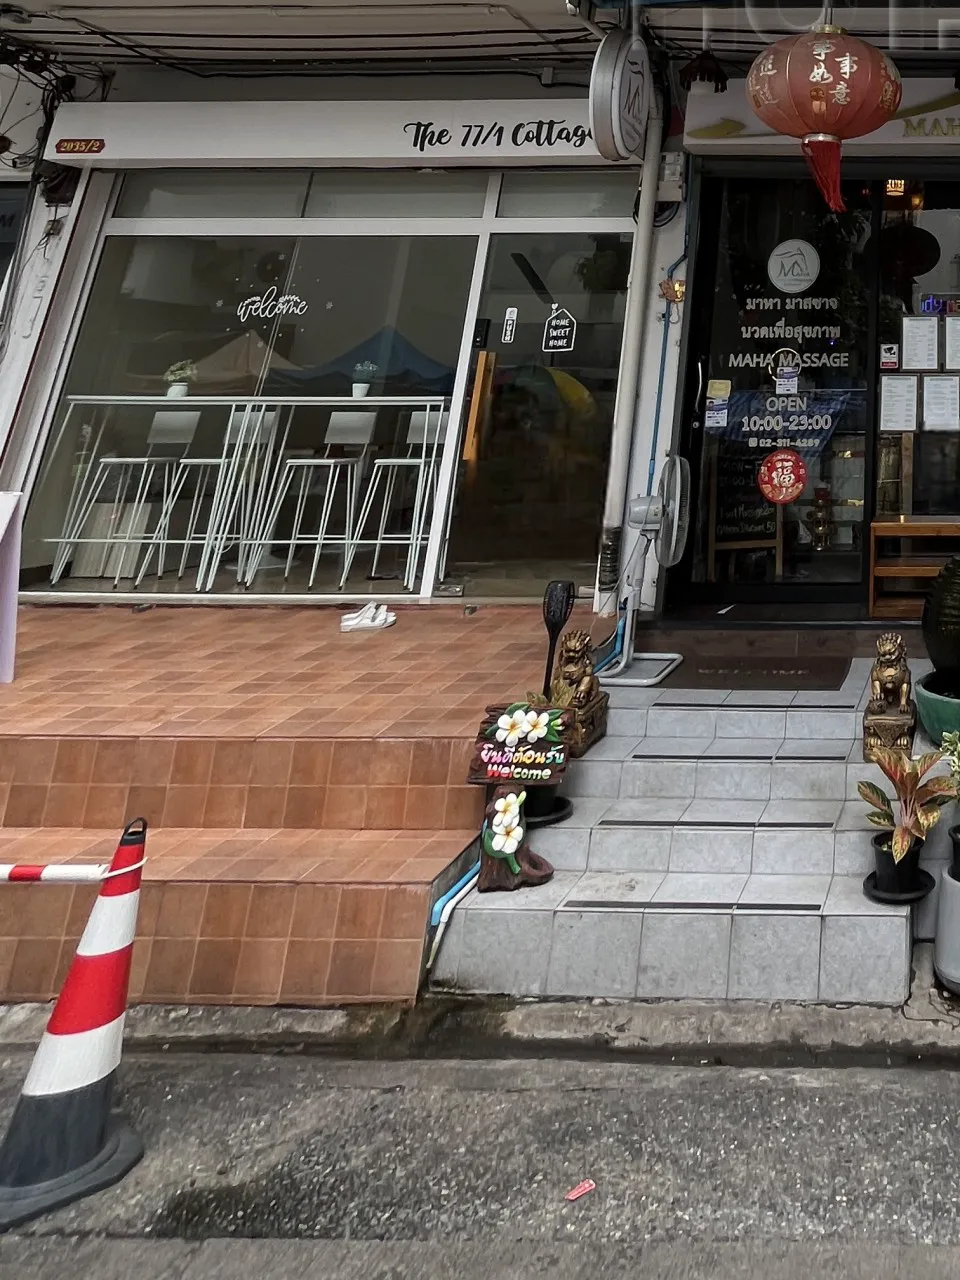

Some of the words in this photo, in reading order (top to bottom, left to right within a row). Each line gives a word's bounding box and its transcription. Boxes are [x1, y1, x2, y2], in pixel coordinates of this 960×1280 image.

[404, 121, 452, 151] The
[461, 121, 504, 147] 77/1
[60, 140, 100, 152] 2035/2
[237, 286, 308, 322] welcome
[746, 297, 781, 310] มาหา
[549, 328, 571, 337] SWEET
[741, 317, 841, 344] นวดเพื่อสุขภาพ
[729, 353, 774, 368] MAHA
[778, 353, 849, 368] MASSAGE
[766, 397, 807, 411] OPEN
[742, 415, 832, 431] 10:00-23:00
[480, 744, 565, 764] ยินดีต้อนรับ
[486, 764, 552, 779] Welcome
